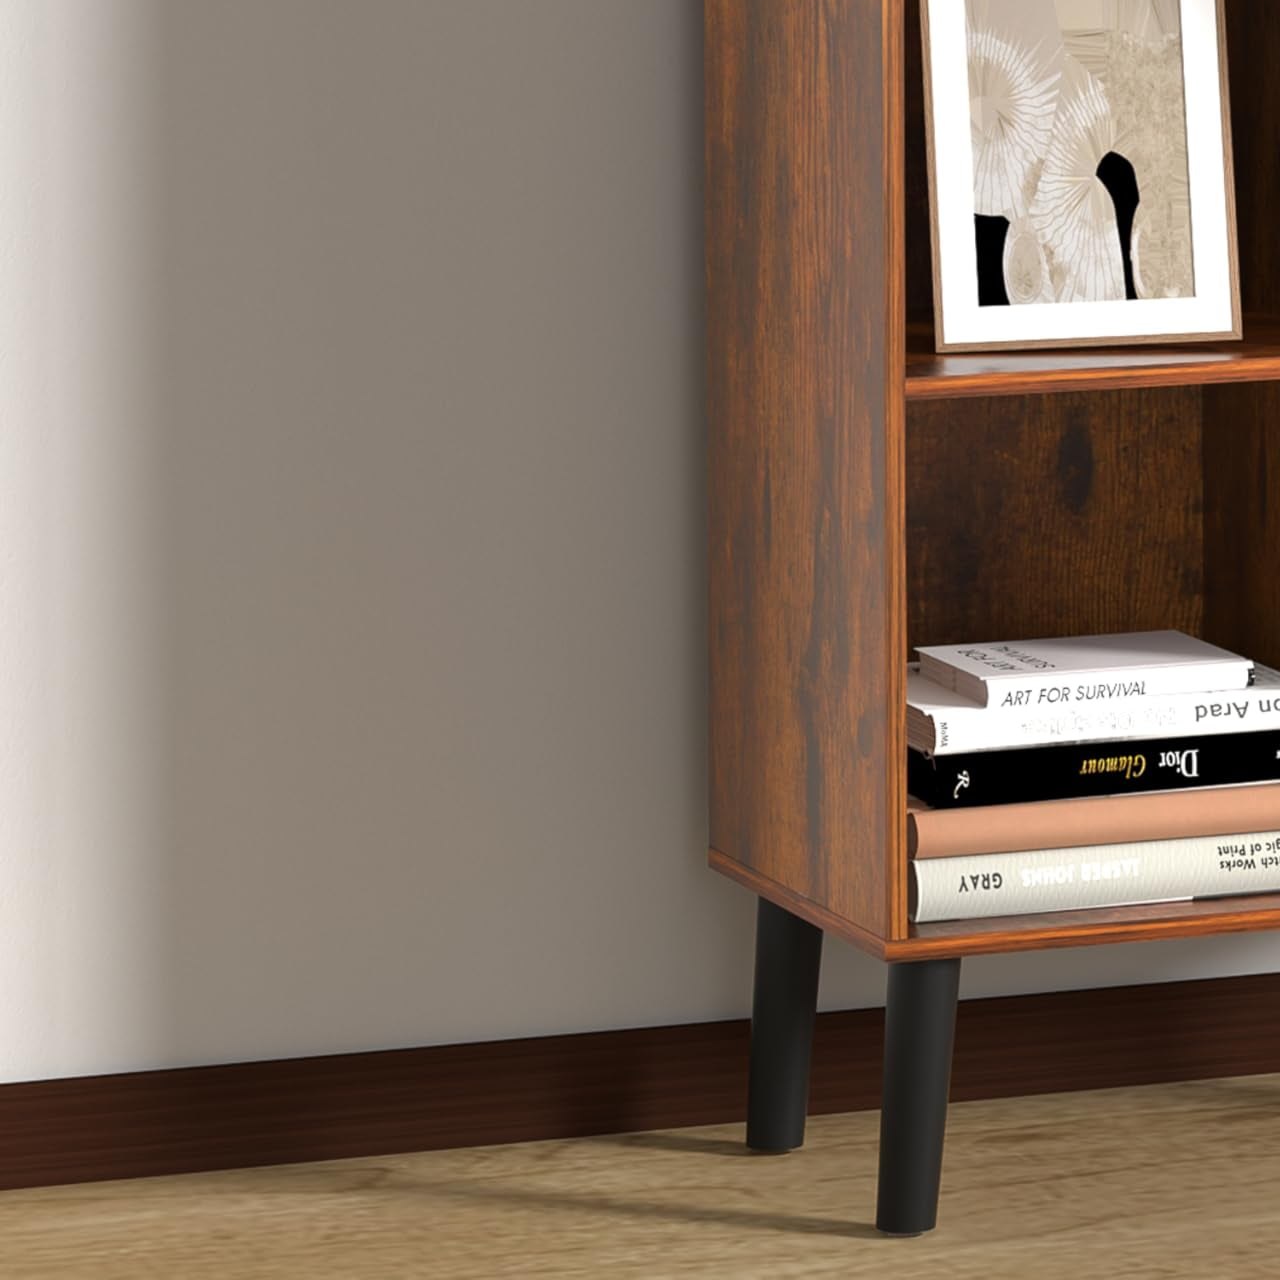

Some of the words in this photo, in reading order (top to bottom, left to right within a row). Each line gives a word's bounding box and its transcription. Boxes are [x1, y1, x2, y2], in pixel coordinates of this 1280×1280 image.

[1001, 690, 1033, 707] ART
[1038, 686, 1071, 704] FOR
[1075, 680, 1147, 702] SURVIVAL
[1195, 701, 1250, 722] Arad
[1079, 753, 1147, 780] Glamour
[1158, 749, 1200, 778] Dior
[1217, 844, 1247, 858] Print
[1250, 843, 1263, 855] of
[1219, 858, 1256, 871] Works
[958, 872, 1003, 894] GRAY
